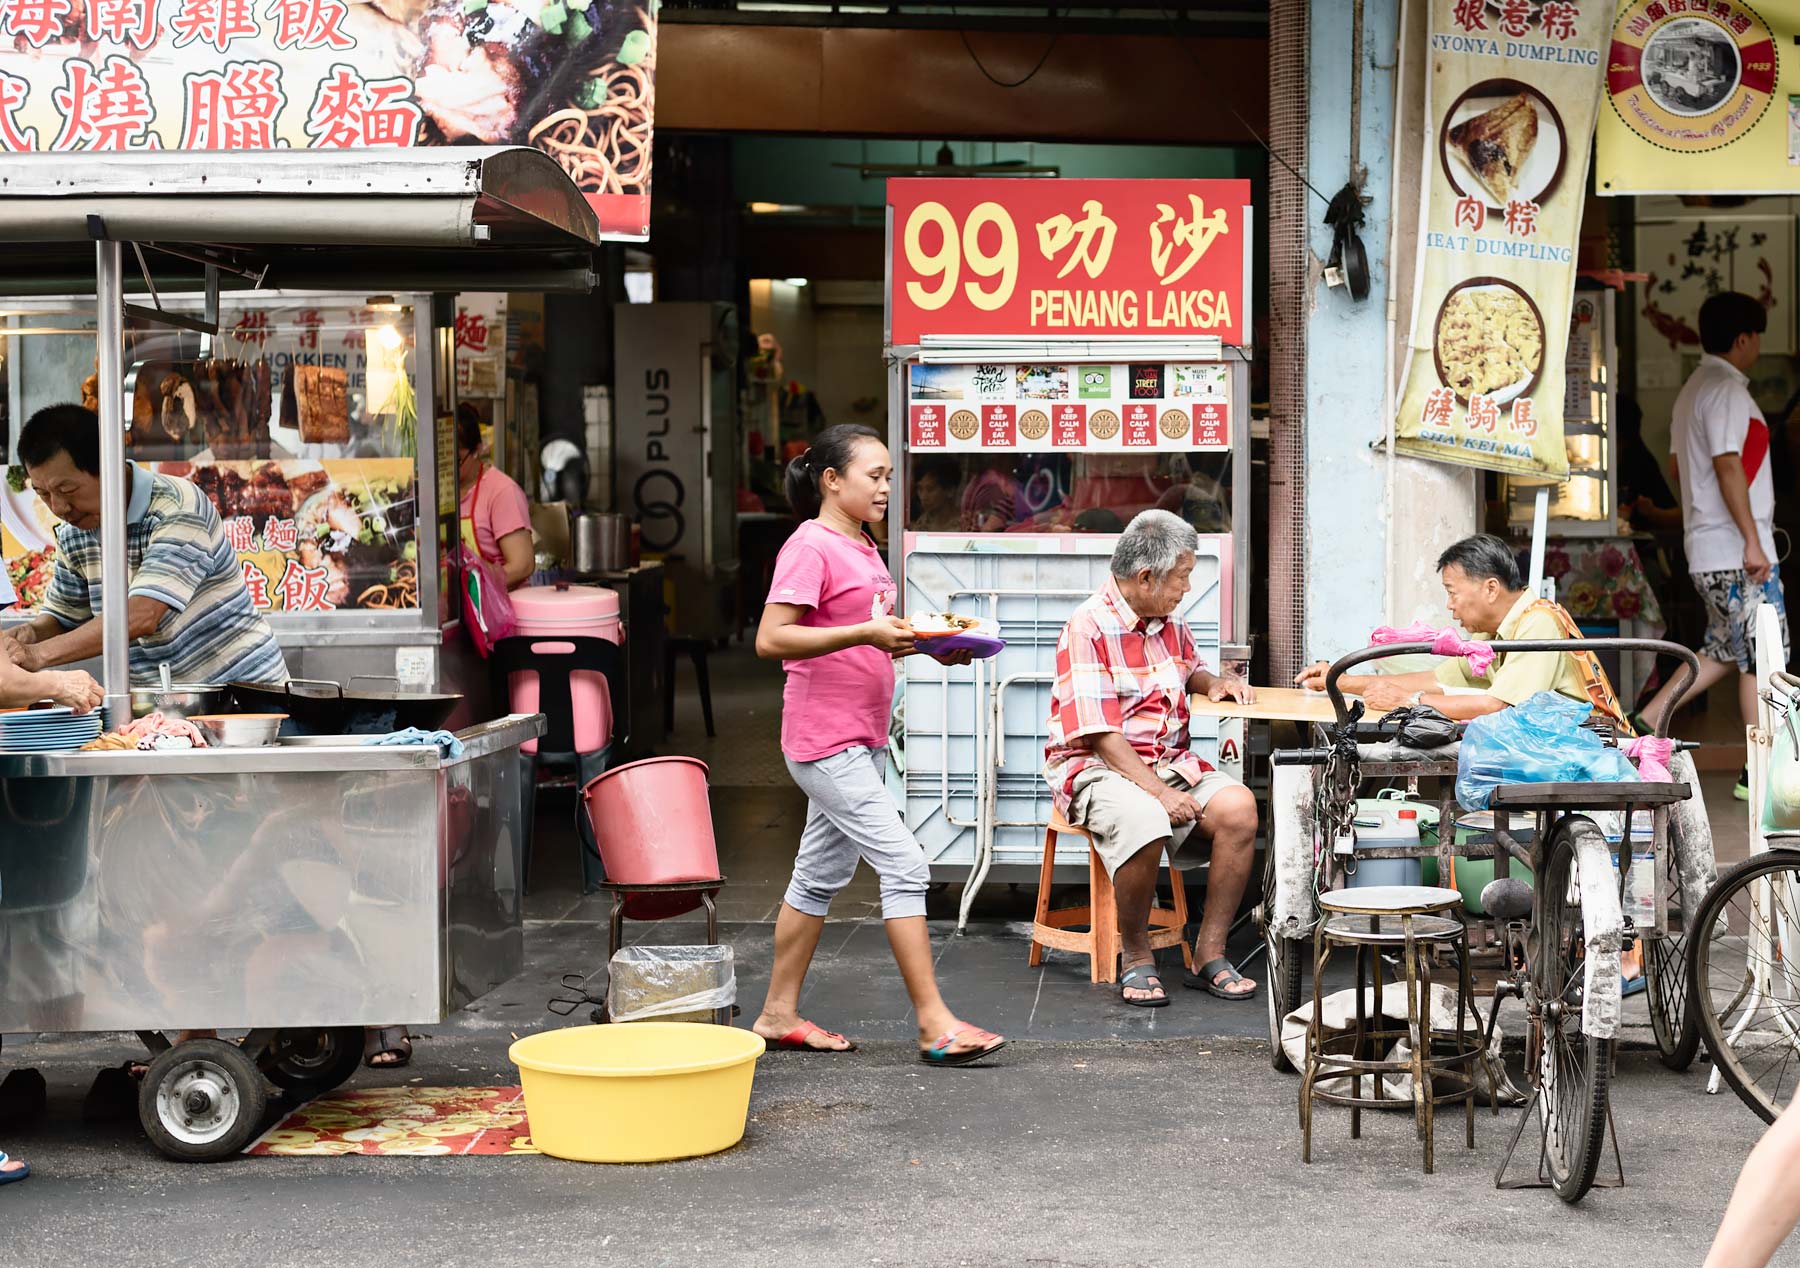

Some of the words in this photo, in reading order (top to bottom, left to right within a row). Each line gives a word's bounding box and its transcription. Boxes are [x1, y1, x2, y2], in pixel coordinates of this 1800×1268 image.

[1453, 0, 1580, 41] 娘惹粽
[1506, 42, 1599, 66] DUMPLING
[1454, 194, 1539, 237] 肉粽
[1036, 194, 1229, 286] 叻沙
[1476, 238, 1572, 263] DUMPLING
[904, 202, 1019, 311] 99
[1030, 290, 1138, 328] PENANG
[1147, 290, 1232, 328] LAKSA
[1134, 388, 1159, 396] FOOD
[1135, 379, 1158, 388] STREET
[1463, 437, 1498, 452] KEI
[1503, 442, 1533, 459] MA
